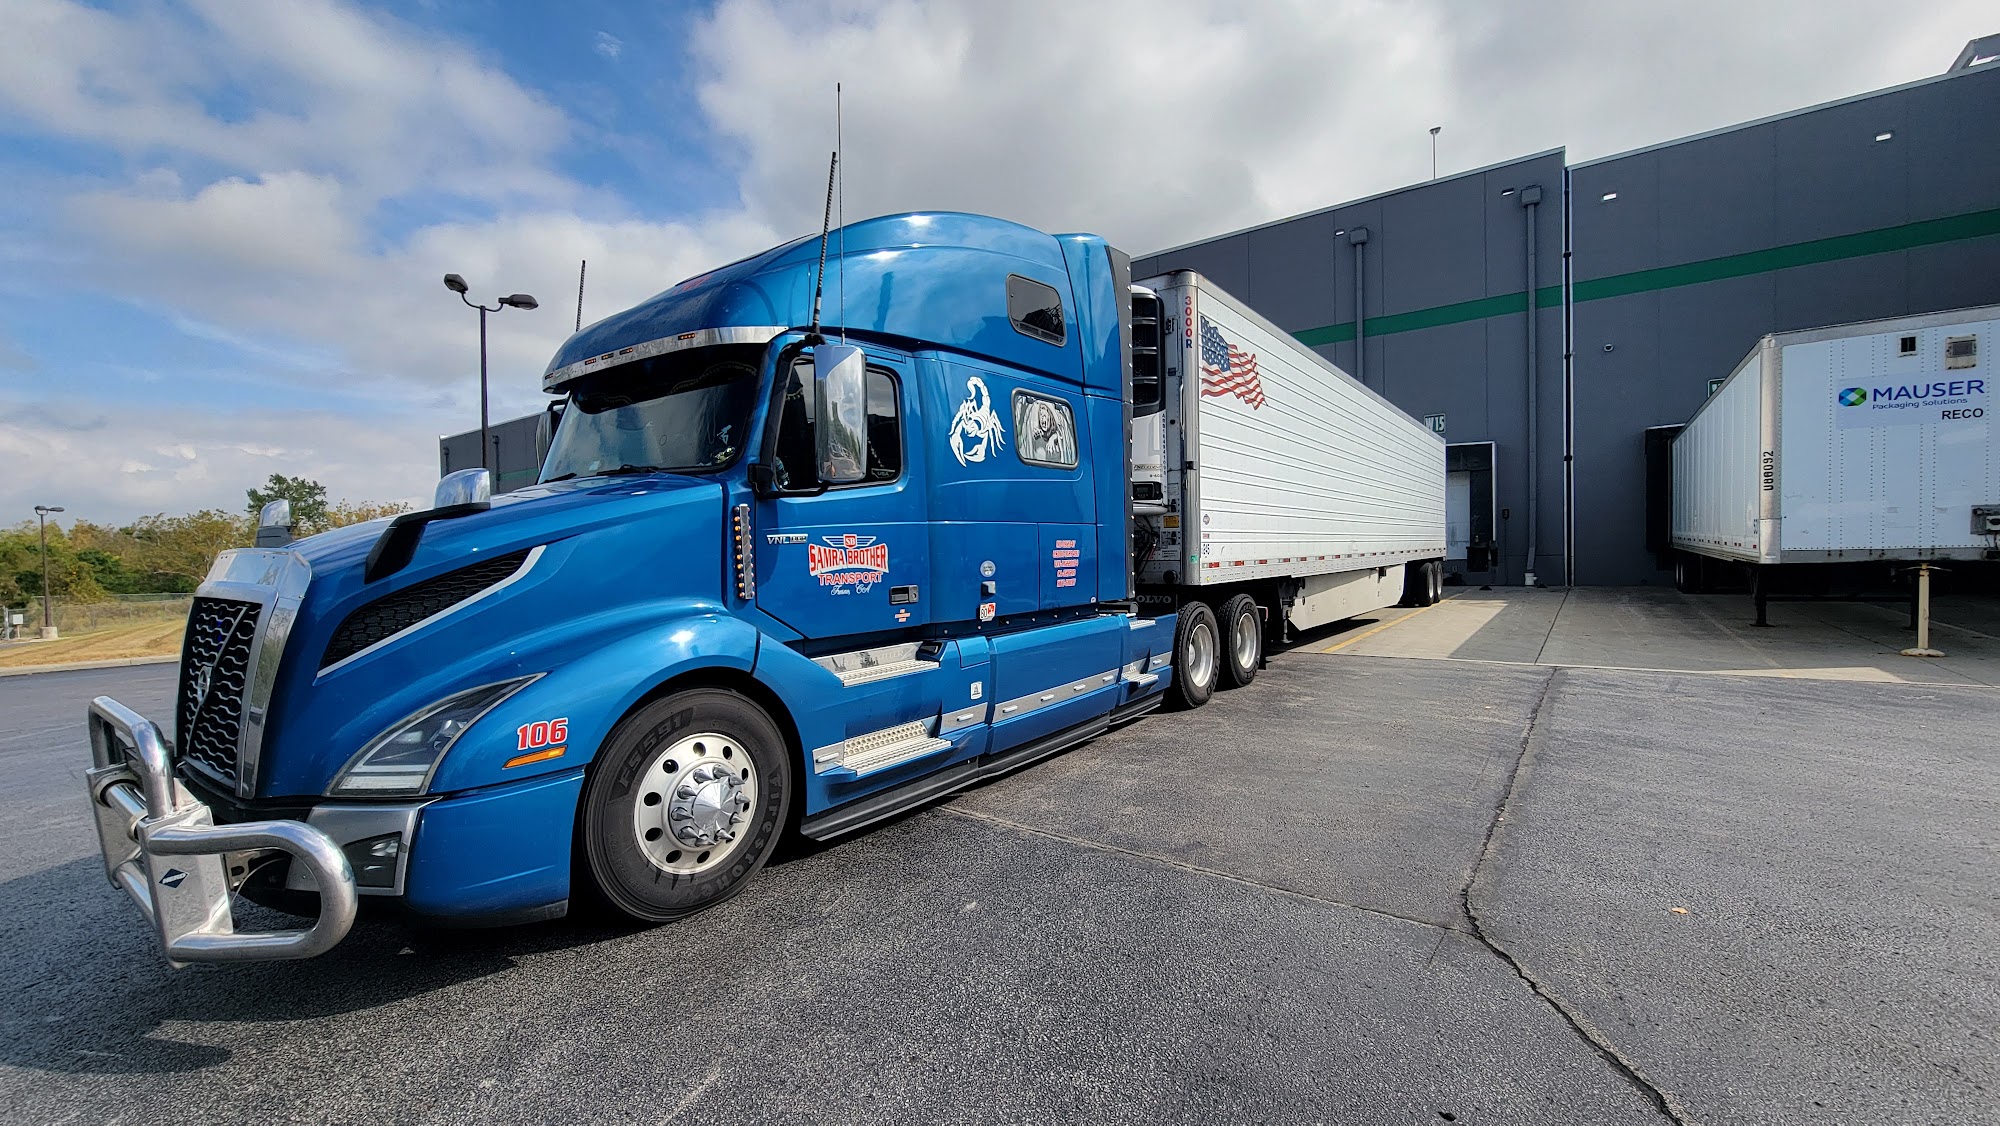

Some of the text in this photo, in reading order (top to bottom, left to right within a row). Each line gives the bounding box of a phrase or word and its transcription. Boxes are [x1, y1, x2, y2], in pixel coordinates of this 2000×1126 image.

[1873, 380, 1985, 402] MAUSER
[1873, 398, 1968, 410] Packaging Solutions
[1942, 408, 1984, 420] RECO
[767, 536, 790, 544] VNL
[845, 537, 856, 545] SB
[809, 544, 888, 575] SAMRA BROTHER
[818, 571, 883, 586] TRANSPORT
[1136, 595, 1172, 603] OLVO
[517, 718, 568, 750] 106
